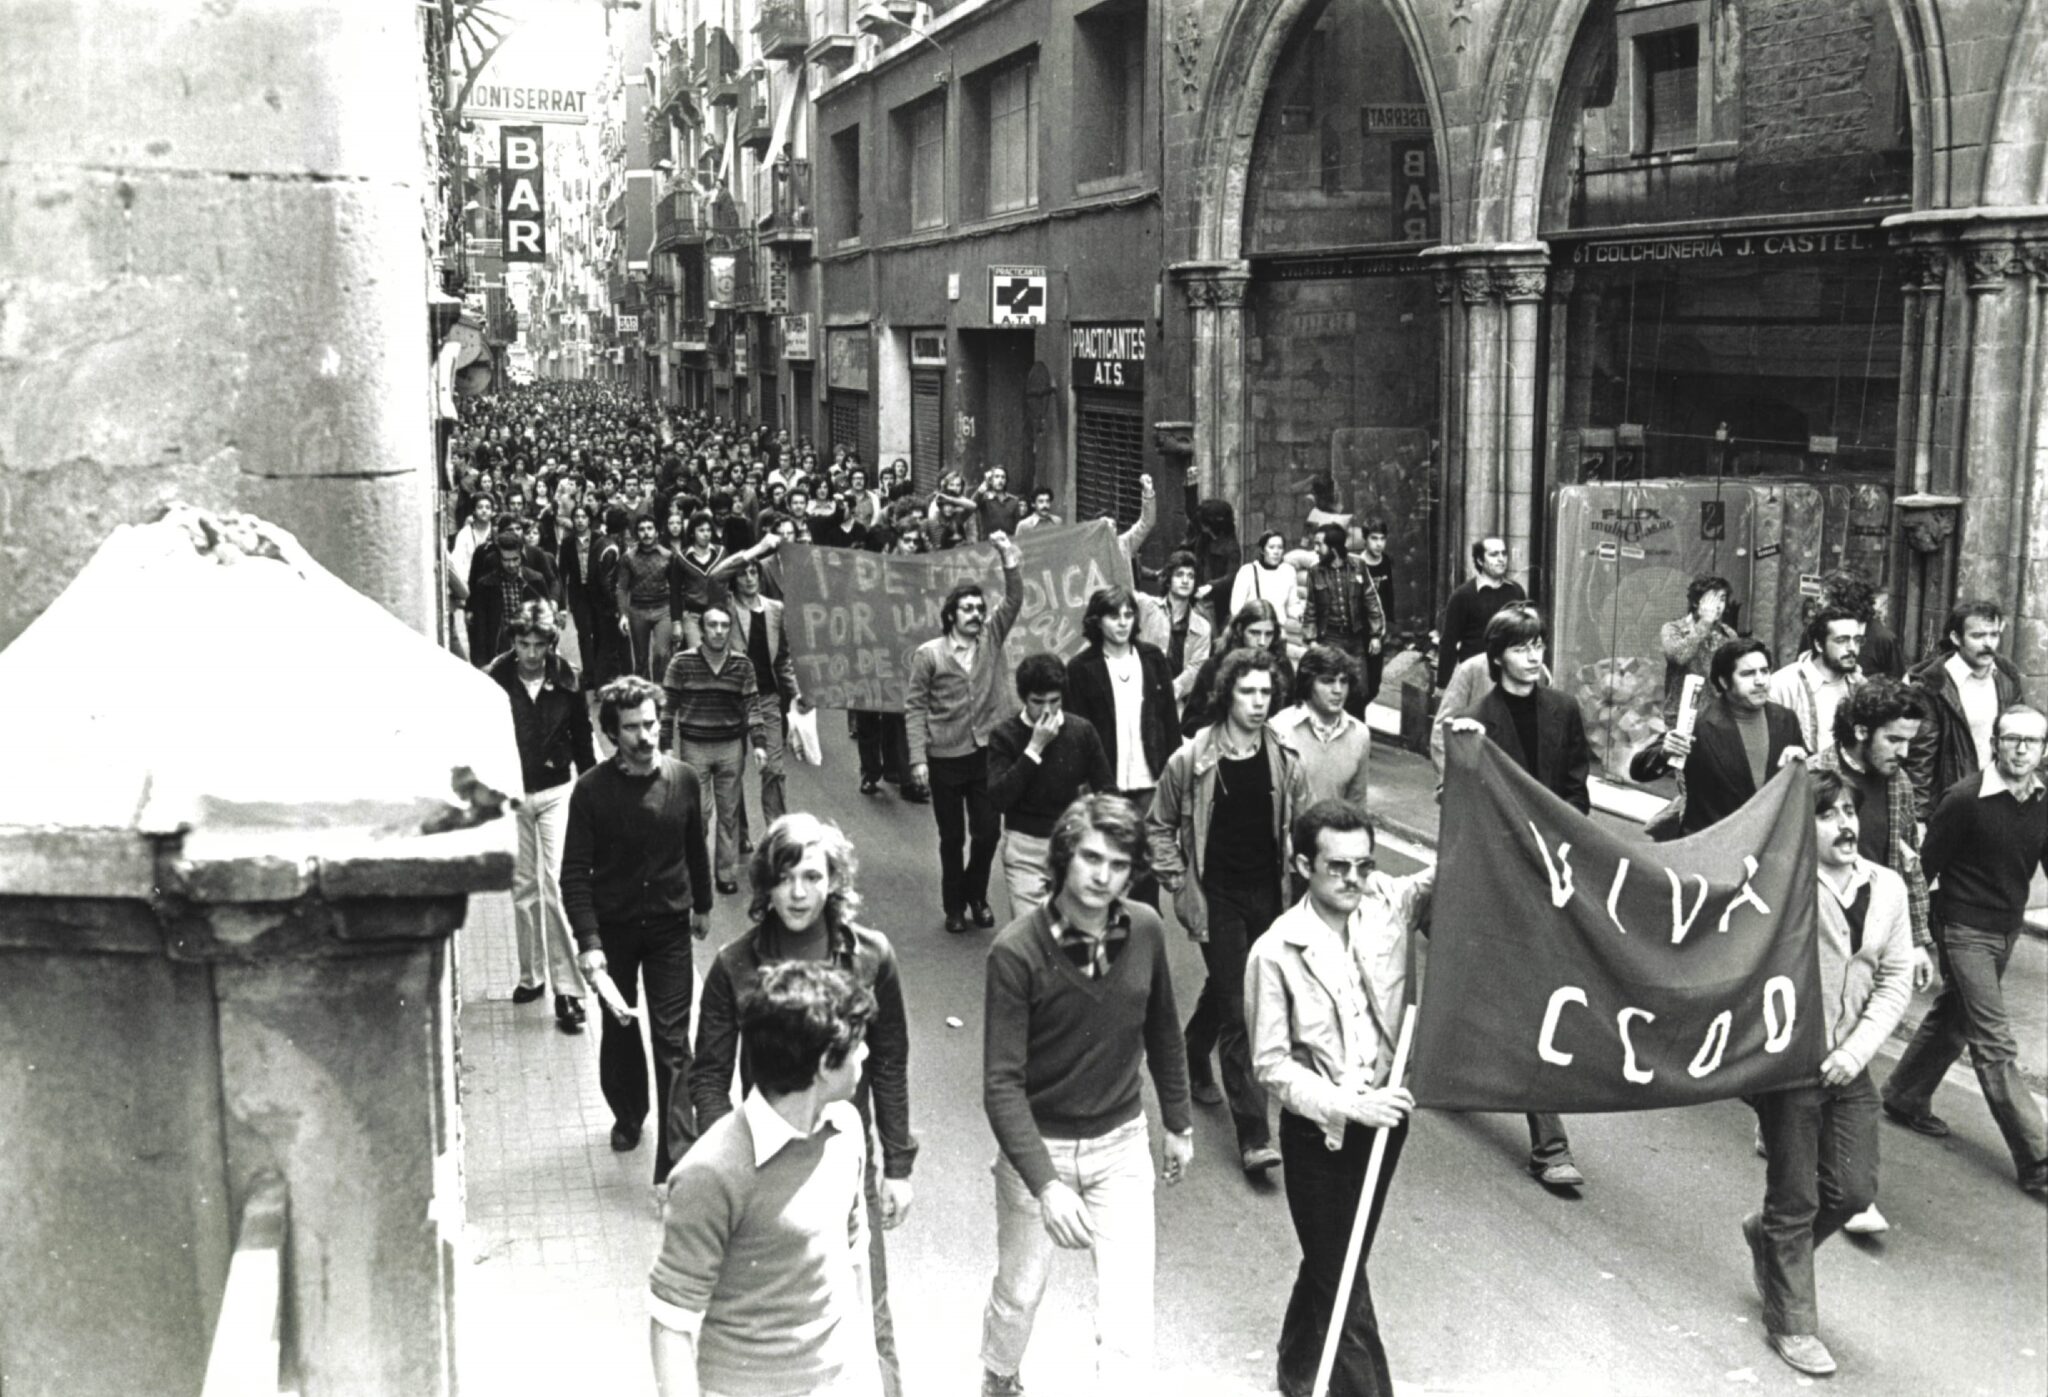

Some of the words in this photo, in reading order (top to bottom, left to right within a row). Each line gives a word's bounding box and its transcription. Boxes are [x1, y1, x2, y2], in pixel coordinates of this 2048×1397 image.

[506, 136, 542, 253] BAR
[1596, 239, 1724, 262] COLCHONERIA
[1072, 327, 1146, 360] PRACTICANTES
[1093, 361, 1125, 386] A.T.S.
[855, 555, 907, 594] DE
[803, 600, 878, 650] POR
[1528, 820, 1772, 944] VIVA
[1537, 975, 1796, 1084] CCOO
